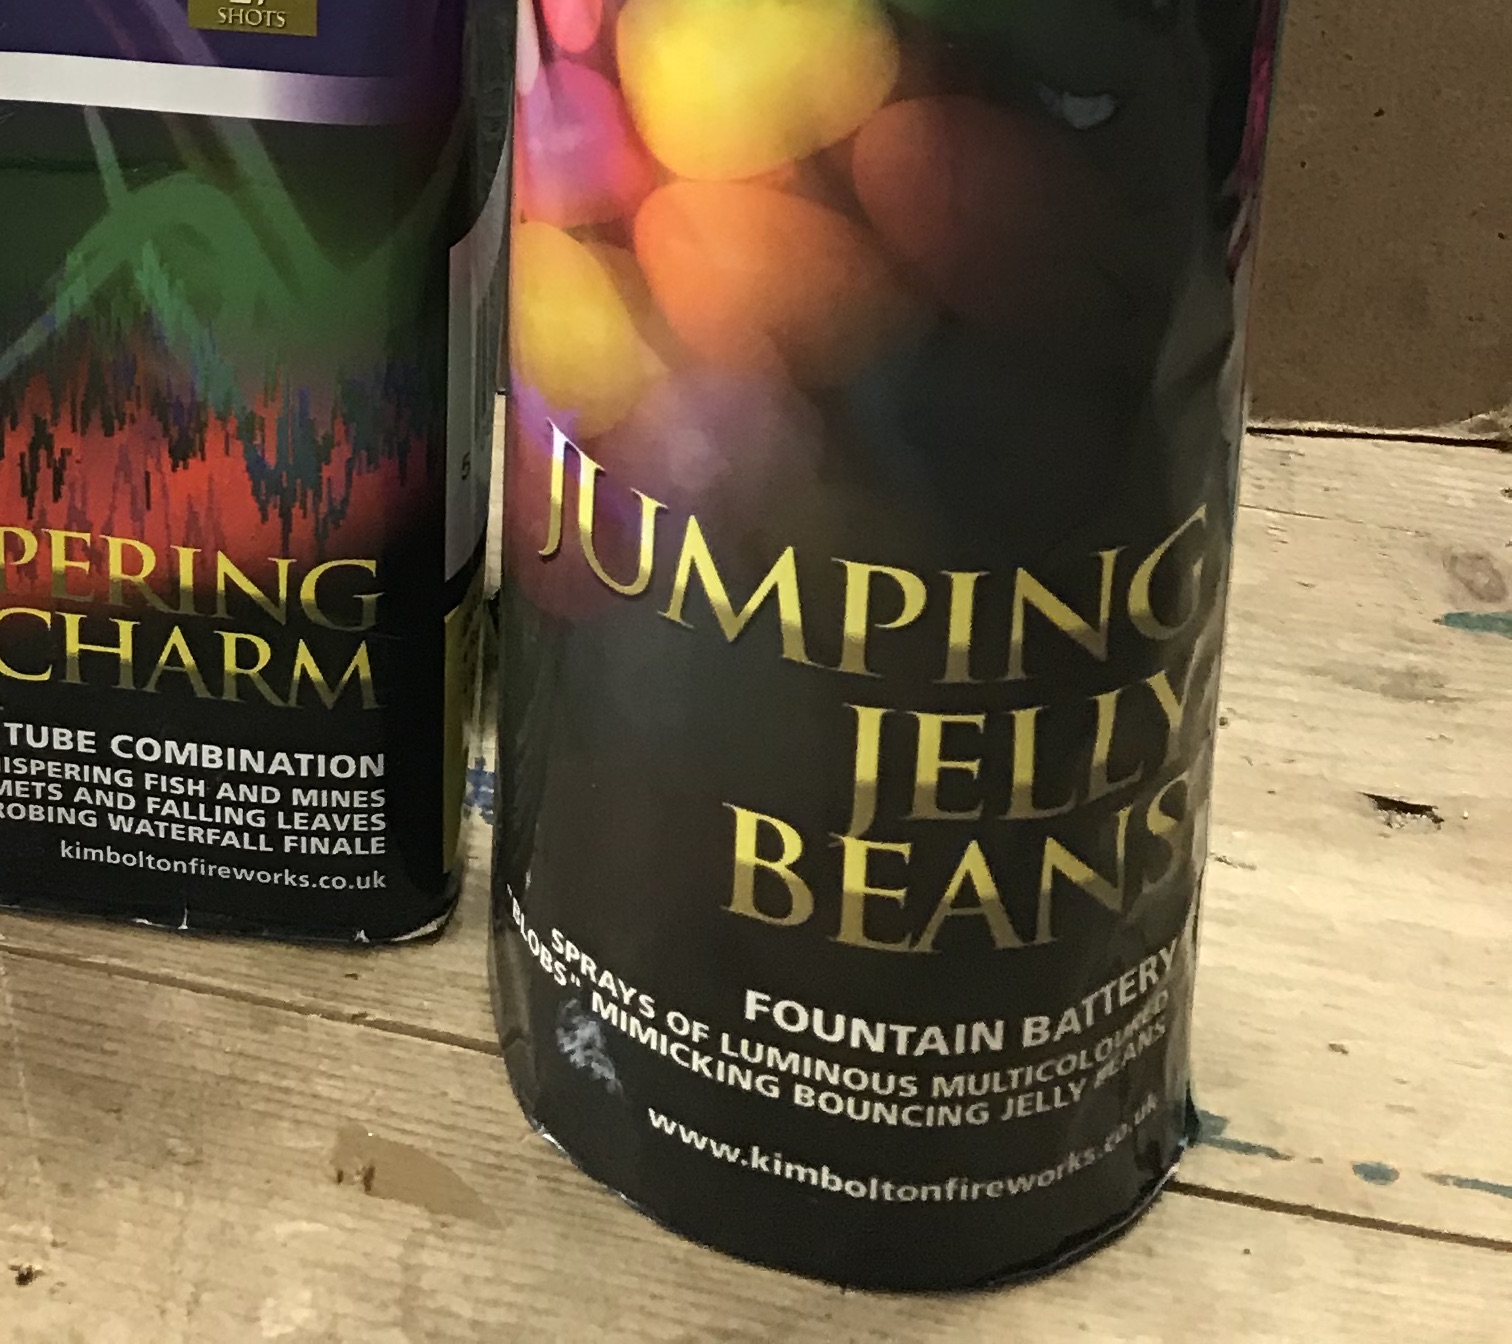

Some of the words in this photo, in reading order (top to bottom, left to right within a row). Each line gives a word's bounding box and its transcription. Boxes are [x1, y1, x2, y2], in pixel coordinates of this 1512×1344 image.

[217, 6, 288, 29] SHOTS
[537, 416, 1210, 684] JUMPING
[4, 721, 98, 755] TUBE
[109, 732, 386, 780] COMBINATION
[143, 771, 207, 799] FISH
[215, 781, 282, 806] AND
[291, 787, 387, 809] MINES
[842, 668, 1190, 838] JELLY
[73, 785, 137, 811] AND
[145, 796, 267, 830] FALLING
[278, 810, 388, 832] LEAVES
[107, 812, 275, 853] WATERFALL
[284, 835, 387, 856] FINALE
[59, 839, 388, 891] kimboltonfireworks.co.uk
[722, 774, 1192, 954] BEANS
[551, 927, 656, 1020] SPRAYS
[666, 1010, 711, 1044] OF
[720, 1032, 918, 1098] LUMINOUS
[743, 989, 1005, 1057] FOUNTAIN
[1022, 937, 1178, 1049] BATTERY
[591, 990, 780, 1100] MIMICKING
[793, 1083, 990, 1128] BOUNCING
[1000, 1077, 1088, 1122] JELLY
